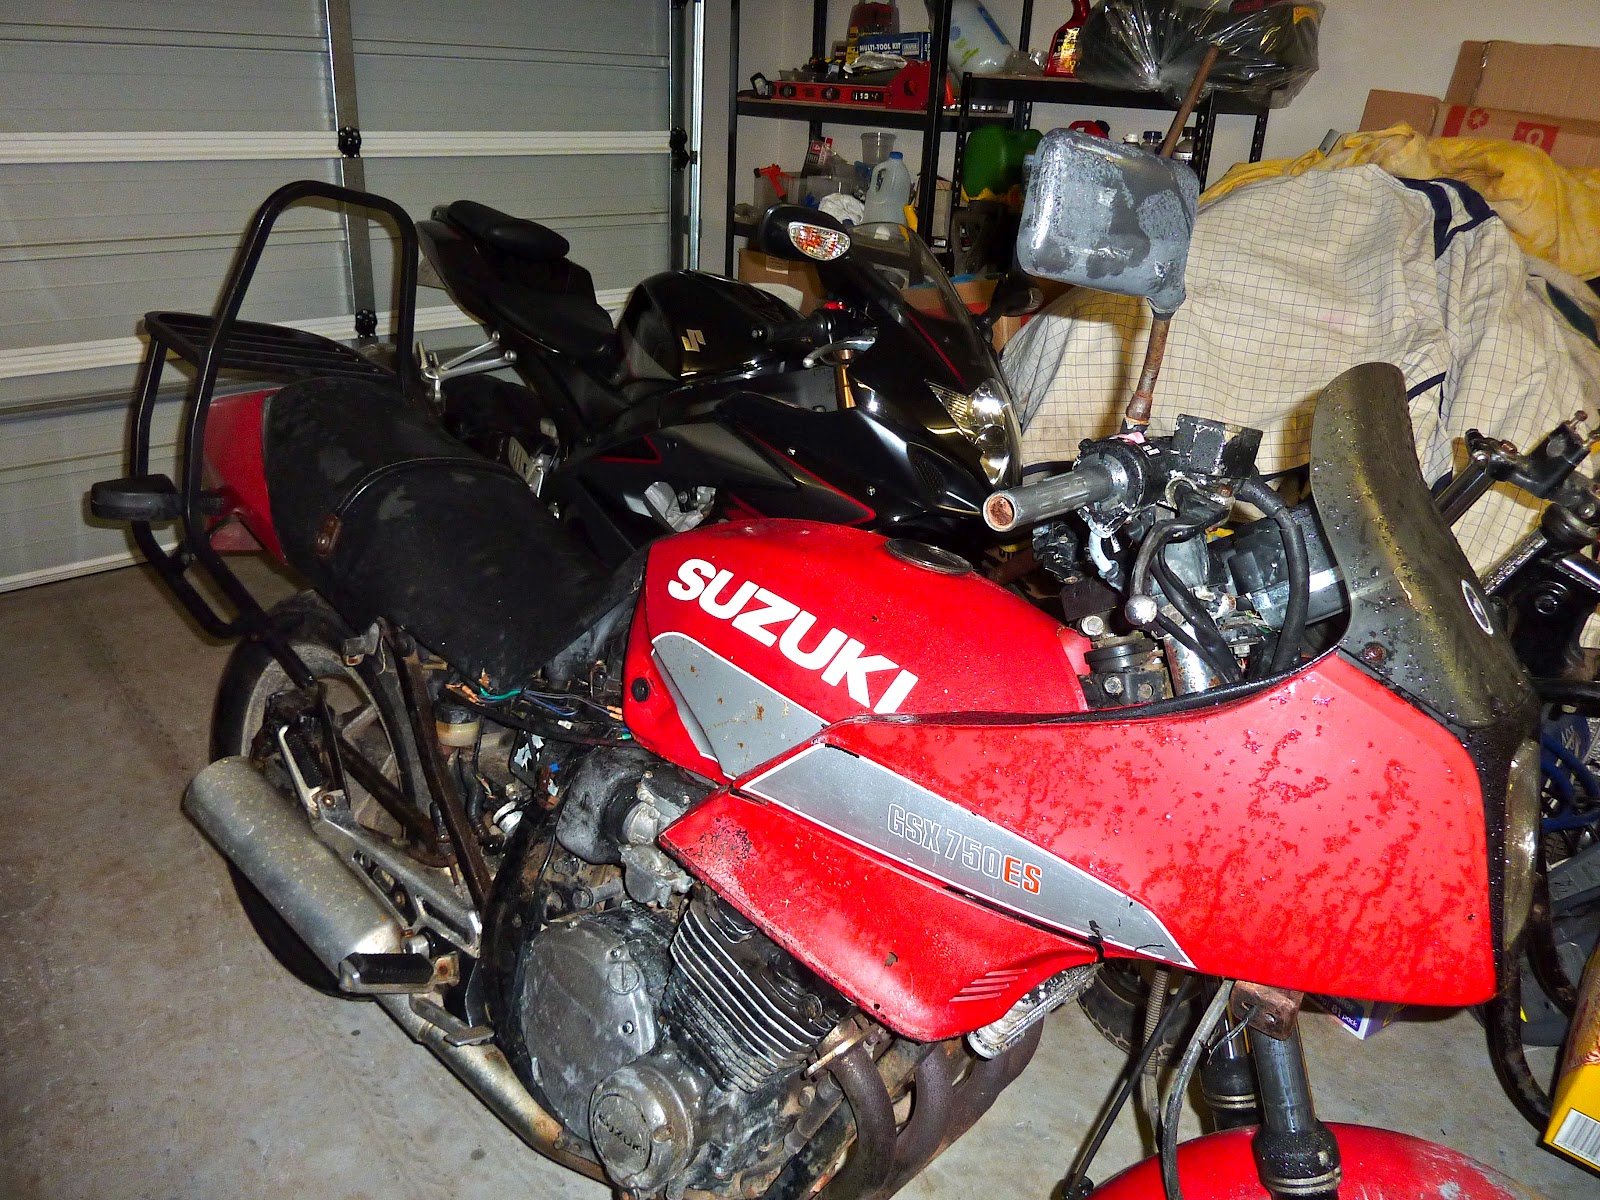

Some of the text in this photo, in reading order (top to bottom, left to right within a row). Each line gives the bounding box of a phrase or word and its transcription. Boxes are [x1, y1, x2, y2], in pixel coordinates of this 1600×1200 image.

[859, 43, 891, 51] MULTI-TOOL
[892, 42, 901, 50] KIT
[667, 558, 919, 714] SUZUKI
[887, 803, 942, 855] GSX
[598, 1113, 646, 1151] SUZUK
